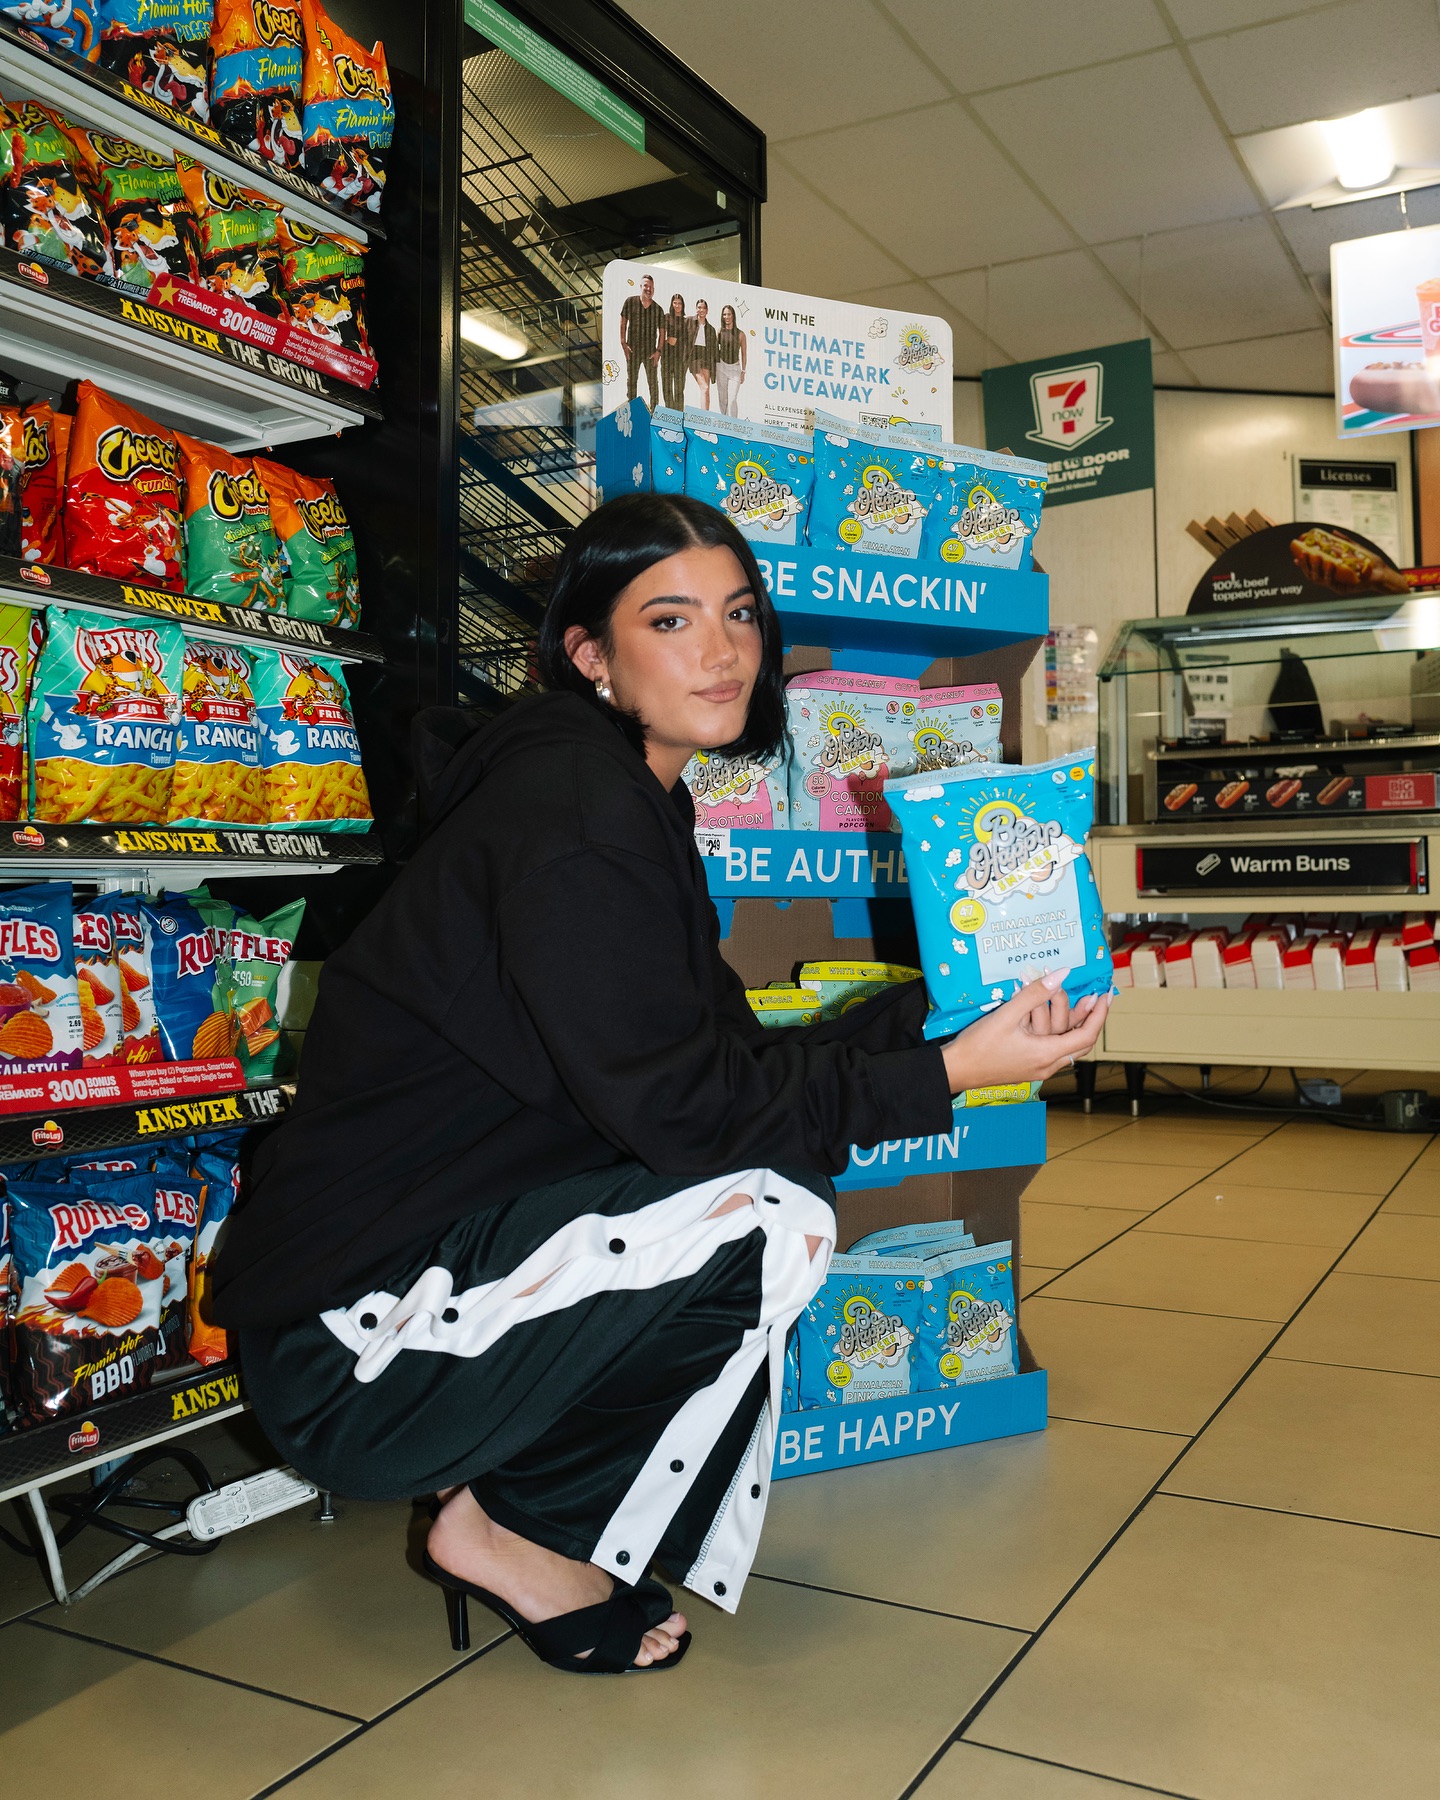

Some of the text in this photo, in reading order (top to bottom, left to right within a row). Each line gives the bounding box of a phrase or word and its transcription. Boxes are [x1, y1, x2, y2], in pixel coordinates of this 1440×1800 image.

[119, 81, 226, 148] ANSWER
[226, 138, 266, 172] THE
[268, 164, 326, 204] GROWL
[177, 293, 218, 317] 7REWARDS
[220, 307, 252, 336] 300
[764, 307, 815, 326] WIN THE
[253, 319, 278, 337] BONUS
[119, 298, 330, 395] ANSWER THE GROWL
[249, 329, 275, 347] POINTS
[764, 326, 866, 360] ULTIMATE
[764, 348, 891, 386] THEME PARK
[764, 372, 874, 404] GIVEAWAY
[764, 404, 806, 416] ALL EXPENSES
[1048, 379, 1086, 434] 7
[1052, 408, 1084, 422] now
[786, 421, 799, 429] THE
[1082, 448, 1130, 467] DOOR
[1048, 465, 1104, 484] ELIVERY
[1320, 468, 1373, 482] Licenses
[746, 501, 784, 519] SNACKS
[845, 523, 857, 532] 47
[862, 541, 910, 556] HIMALAYAN
[947, 544, 960, 553] 47
[811, 565, 988, 614] SNACKIN'
[1212, 576, 1270, 591] 100% beef
[1212, 584, 1304, 603] topped your way
[120, 585, 332, 645] ANSWER THE GROWL
[79, 631, 164, 674] CHESTER'S
[816, 675, 887, 690] COTTON CANDY
[936, 691, 965, 700] CANDY
[118, 703, 158, 716] FRIES
[209, 704, 241, 717] FRIES
[97, 724, 174, 752] RANCH
[195, 725, 257, 751] RANCH
[307, 728, 360, 750] RANCH
[711, 771, 750, 800] SNACKS
[831, 790, 883, 803] COTTON
[835, 805, 879, 816] CANDY
[708, 813, 764, 829] COTTON
[980, 807, 1026, 844] Be
[115, 831, 331, 857] ANSWER THE GROWL
[726, 847, 772, 882] BE
[966, 820, 1063, 890] Happy
[1230, 854, 1352, 874] Warm Buns
[997, 849, 1053, 892] SNACKS
[959, 905, 974, 917] 47
[990, 910, 1068, 933] HIMALAYAN
[982, 921, 1078, 954] PINK SALT
[1008, 948, 1061, 965] POPCORN
[828, 966, 856, 976] WHITE
[129, 1069, 146, 1077] When
[146, 1068, 157, 1077] you
[157, 1066, 167, 1076] buy
[159, 1076, 176, 1085] Baked
[183, 1074, 201, 1084] Simply
[201, 1073, 217, 1082] Single
[217, 1071, 233, 1080] Serve
[48, 1079, 88, 1102] 300
[86, 1076, 116, 1088] BONUS
[160, 1086, 175, 1095] Chips
[0, 1087, 44, 1100] REWARDS
[89, 1086, 120, 1098] POINTS
[970, 1087, 1027, 1100] CHEDDAR
[136, 1088, 285, 1134] ANSWER THE
[851, 1126, 970, 1167] OPPIN'
[842, 1260, 915, 1271] SALT HIMALAYAN
[848, 1300, 879, 1329] Be
[968, 1318, 1000, 1349] SNACKS
[119, 1334, 143, 1357] Hot
[859, 1333, 897, 1361] SNACKS
[833, 1365, 845, 1375] 47
[944, 1357, 955, 1367] 47
[965, 1363, 1010, 1379] HIMALAYAN
[91, 1356, 134, 1401] BBQ
[853, 1380, 903, 1391] HIMALAYAN
[171, 1374, 240, 1420] ANSW
[780, 1401, 962, 1465] BE HAPPY
